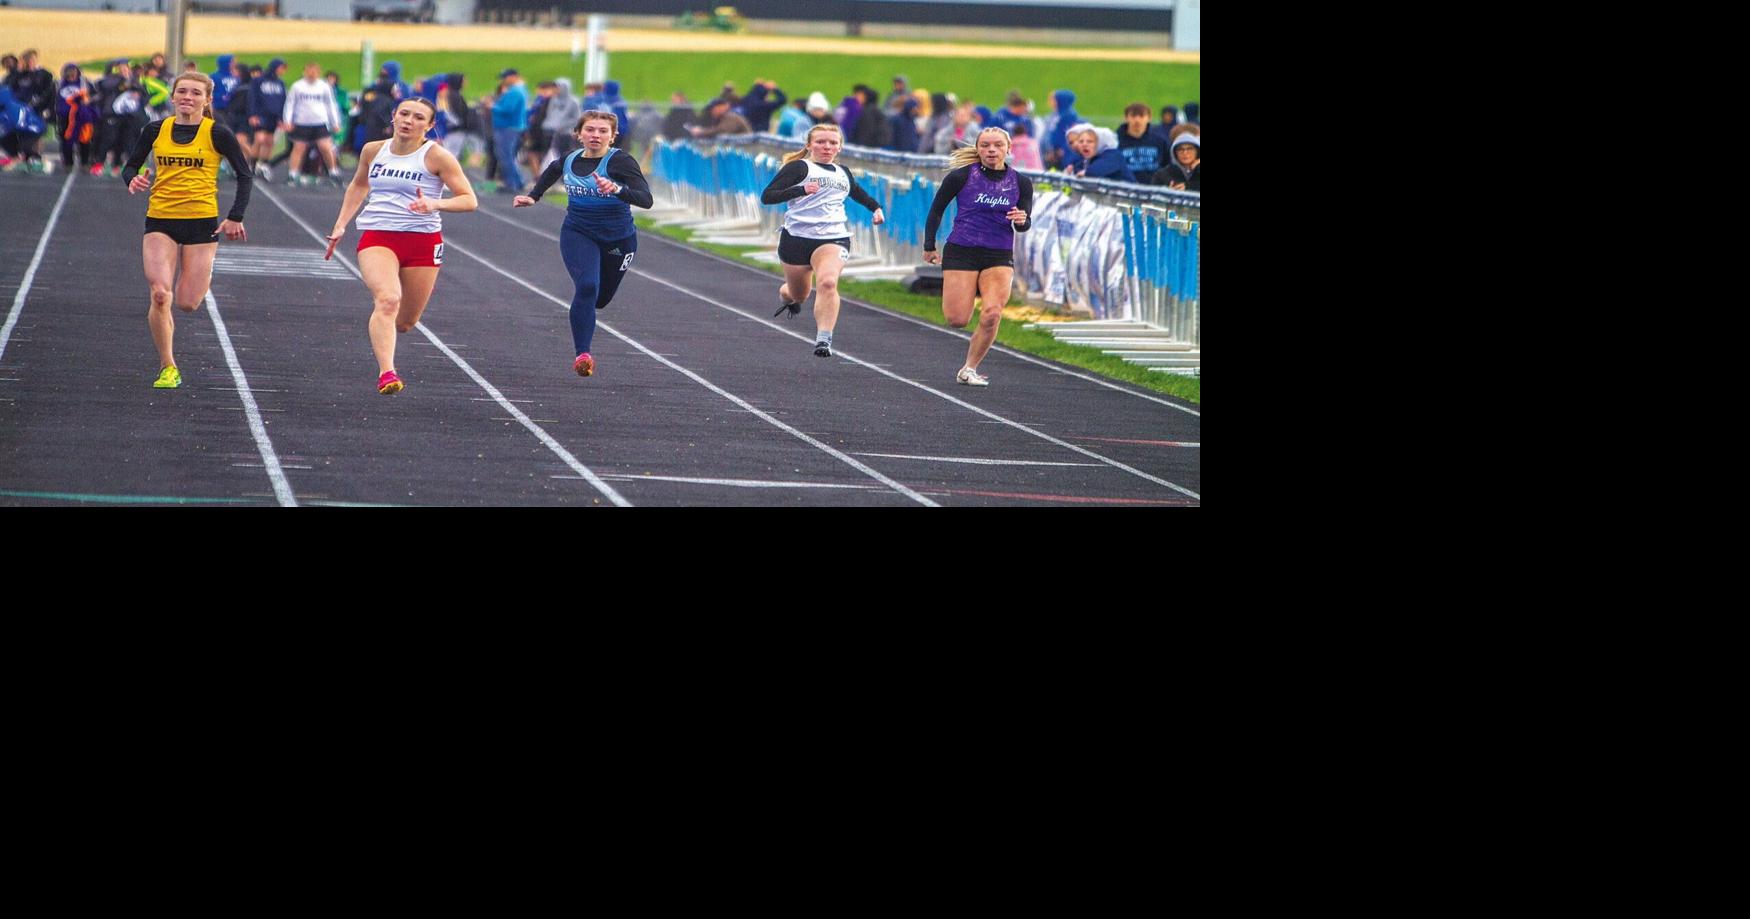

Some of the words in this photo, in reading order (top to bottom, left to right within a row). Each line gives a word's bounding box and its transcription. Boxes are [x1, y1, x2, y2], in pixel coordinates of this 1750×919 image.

[157, 156, 204, 168] TIPTON
[370, 163, 423, 181] CAMANCHE
[974, 192, 1010, 207] Knights
[622, 252, 634, 270] 3
